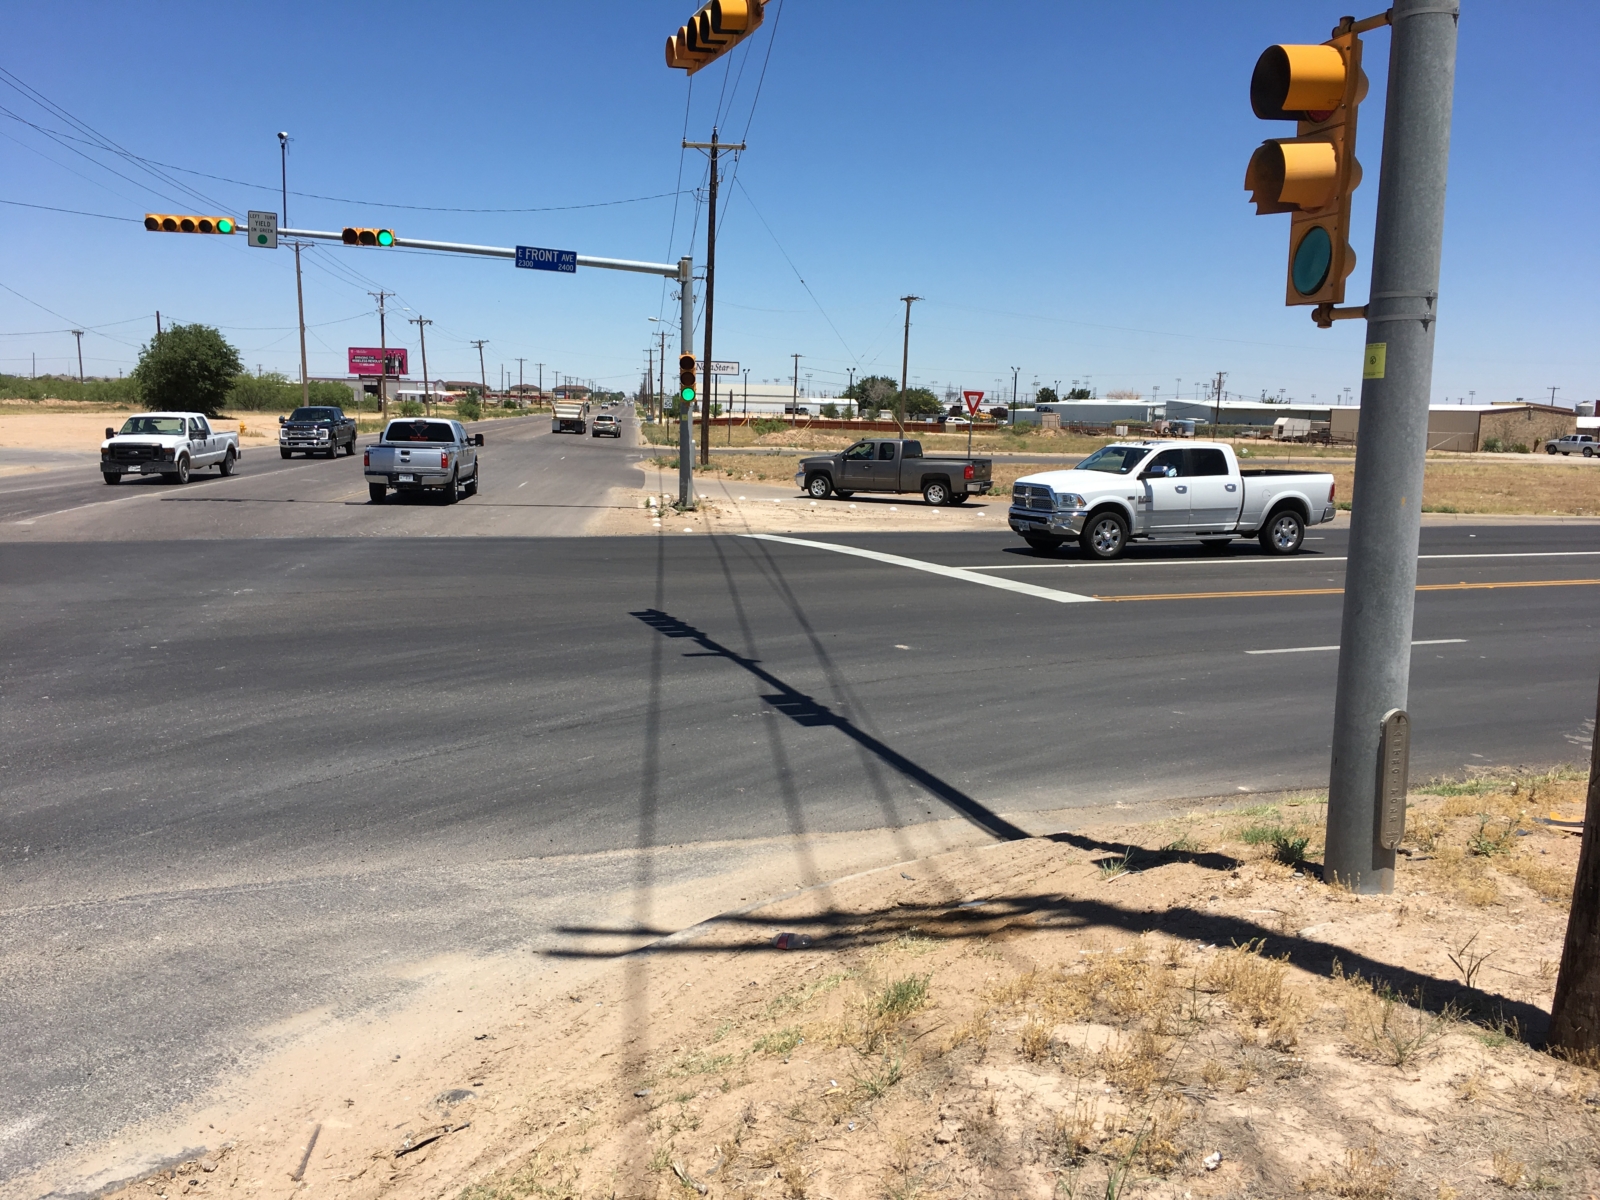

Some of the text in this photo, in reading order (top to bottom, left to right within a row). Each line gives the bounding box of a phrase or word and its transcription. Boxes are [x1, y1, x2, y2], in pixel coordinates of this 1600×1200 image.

[518, 248, 574, 263] E FRONT AVE
